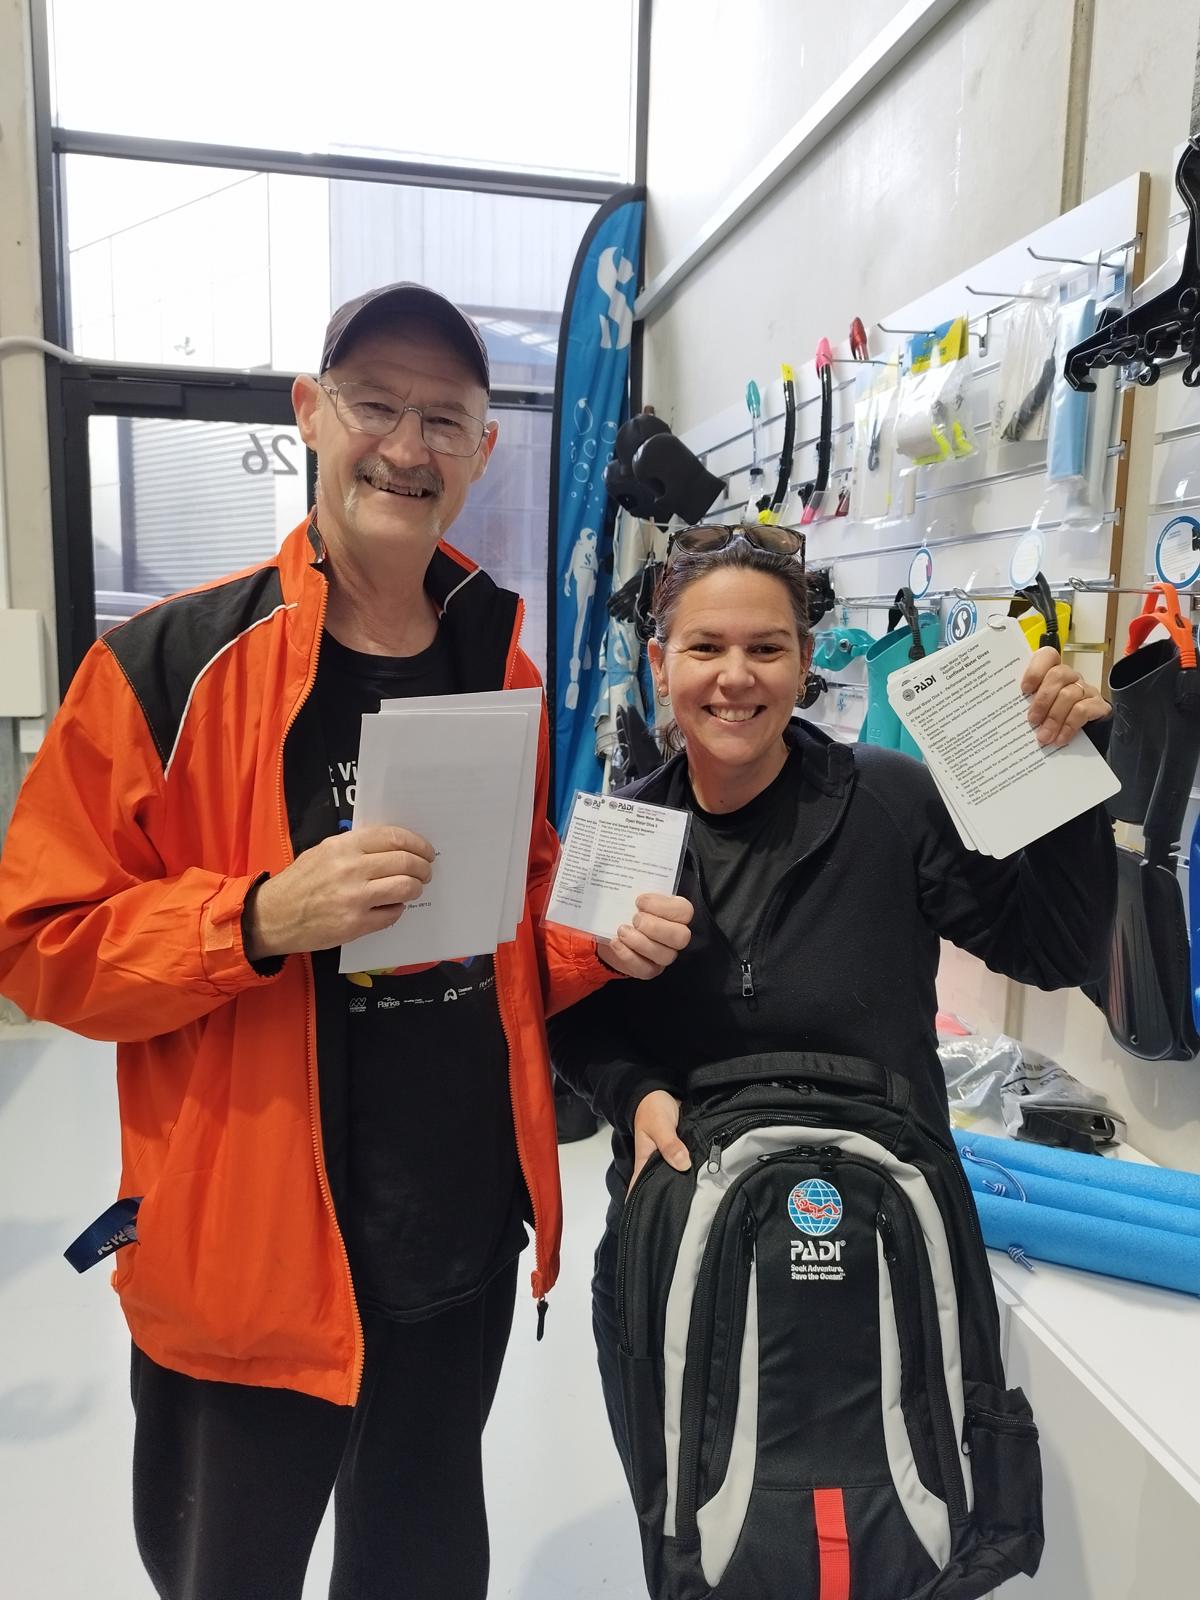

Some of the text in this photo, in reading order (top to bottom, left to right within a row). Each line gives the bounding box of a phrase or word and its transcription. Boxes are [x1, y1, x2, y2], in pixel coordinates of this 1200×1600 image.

[945, 649, 990, 680] Confined Water Dives
[913, 674, 936, 694] PADI
[617, 802, 634, 811] PADI
[790, 1240, 842, 1261] PADI
[791, 1264, 808, 1272] Seek
[792, 1272, 808, 1280] Save
[807, 1272, 820, 1281] the
